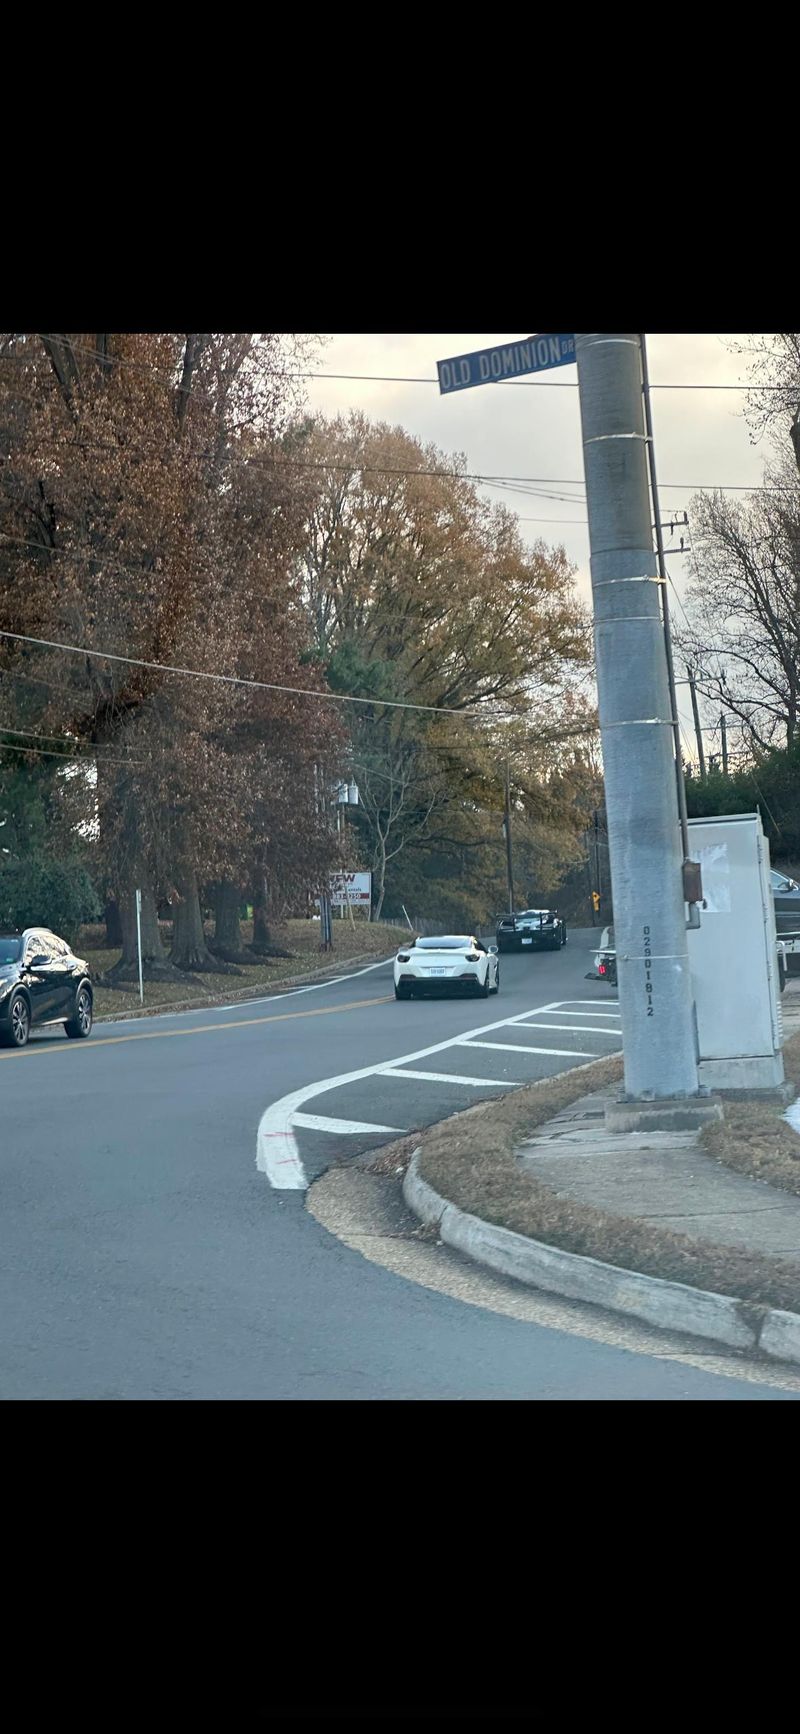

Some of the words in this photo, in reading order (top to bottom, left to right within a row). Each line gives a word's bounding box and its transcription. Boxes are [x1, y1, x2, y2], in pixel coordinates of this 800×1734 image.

[441, 360, 471, 389] OLD
[480, 336, 561, 380] DOMINION
[561, 339, 575, 354] DR
[643, 926, 654, 1017] 02901812
